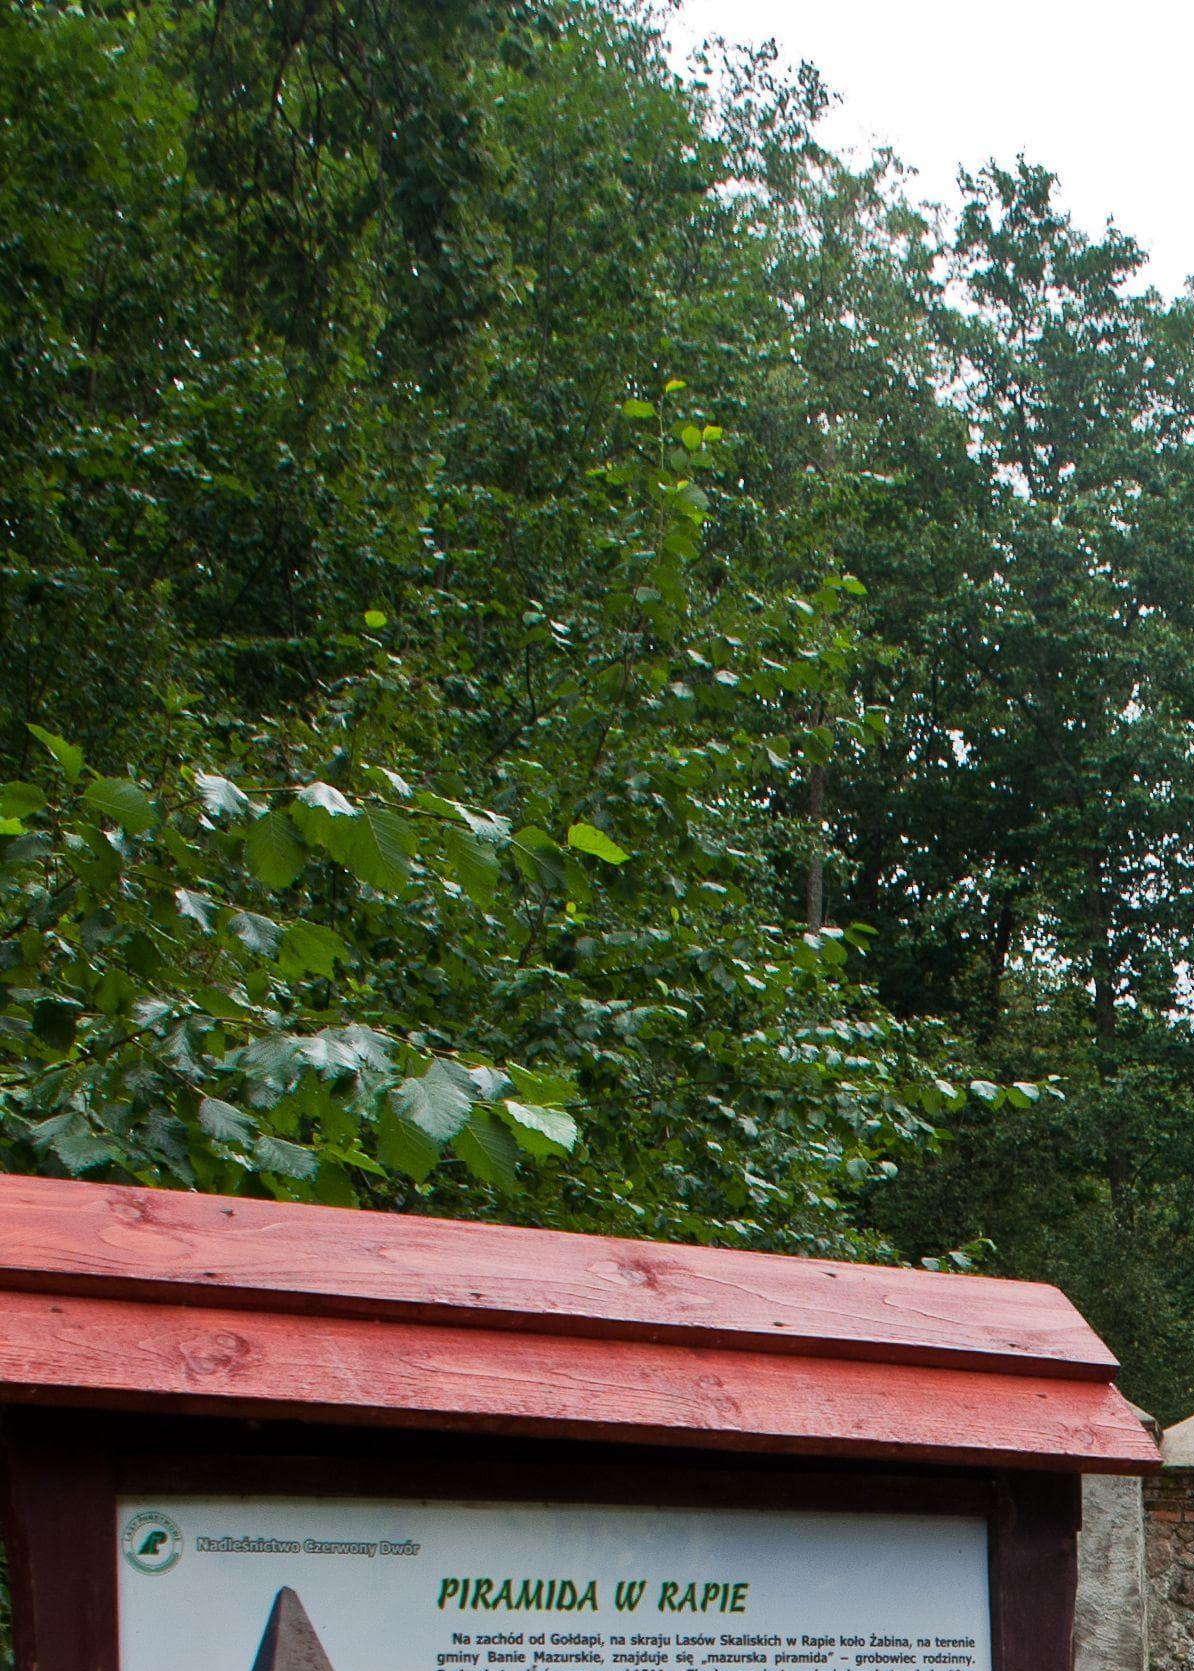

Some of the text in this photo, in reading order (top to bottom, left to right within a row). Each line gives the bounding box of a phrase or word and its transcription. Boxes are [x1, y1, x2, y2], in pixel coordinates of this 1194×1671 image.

[196, 1536, 421, 1558] Nadleśnictwo Czerwony Dwór
[437, 1577, 750, 1613] PIRAMIDA W RAPIE
[451, 1633, 975, 1649] Na zachód od Gołdapi, na skraju Lasów Skaliskich w Rapie koło Żabina, na terenie
[436, 1651, 479, 1665] gminy
[488, 1651, 525, 1662] Banie
[534, 1651, 604, 1664] Mazurskie,
[613, 1651, 668, 1665] znajduje
[676, 1651, 693, 1665] się
[856, 1652, 916, 1666] grobowiec
[923, 1652, 976, 1667] rodzinny.
